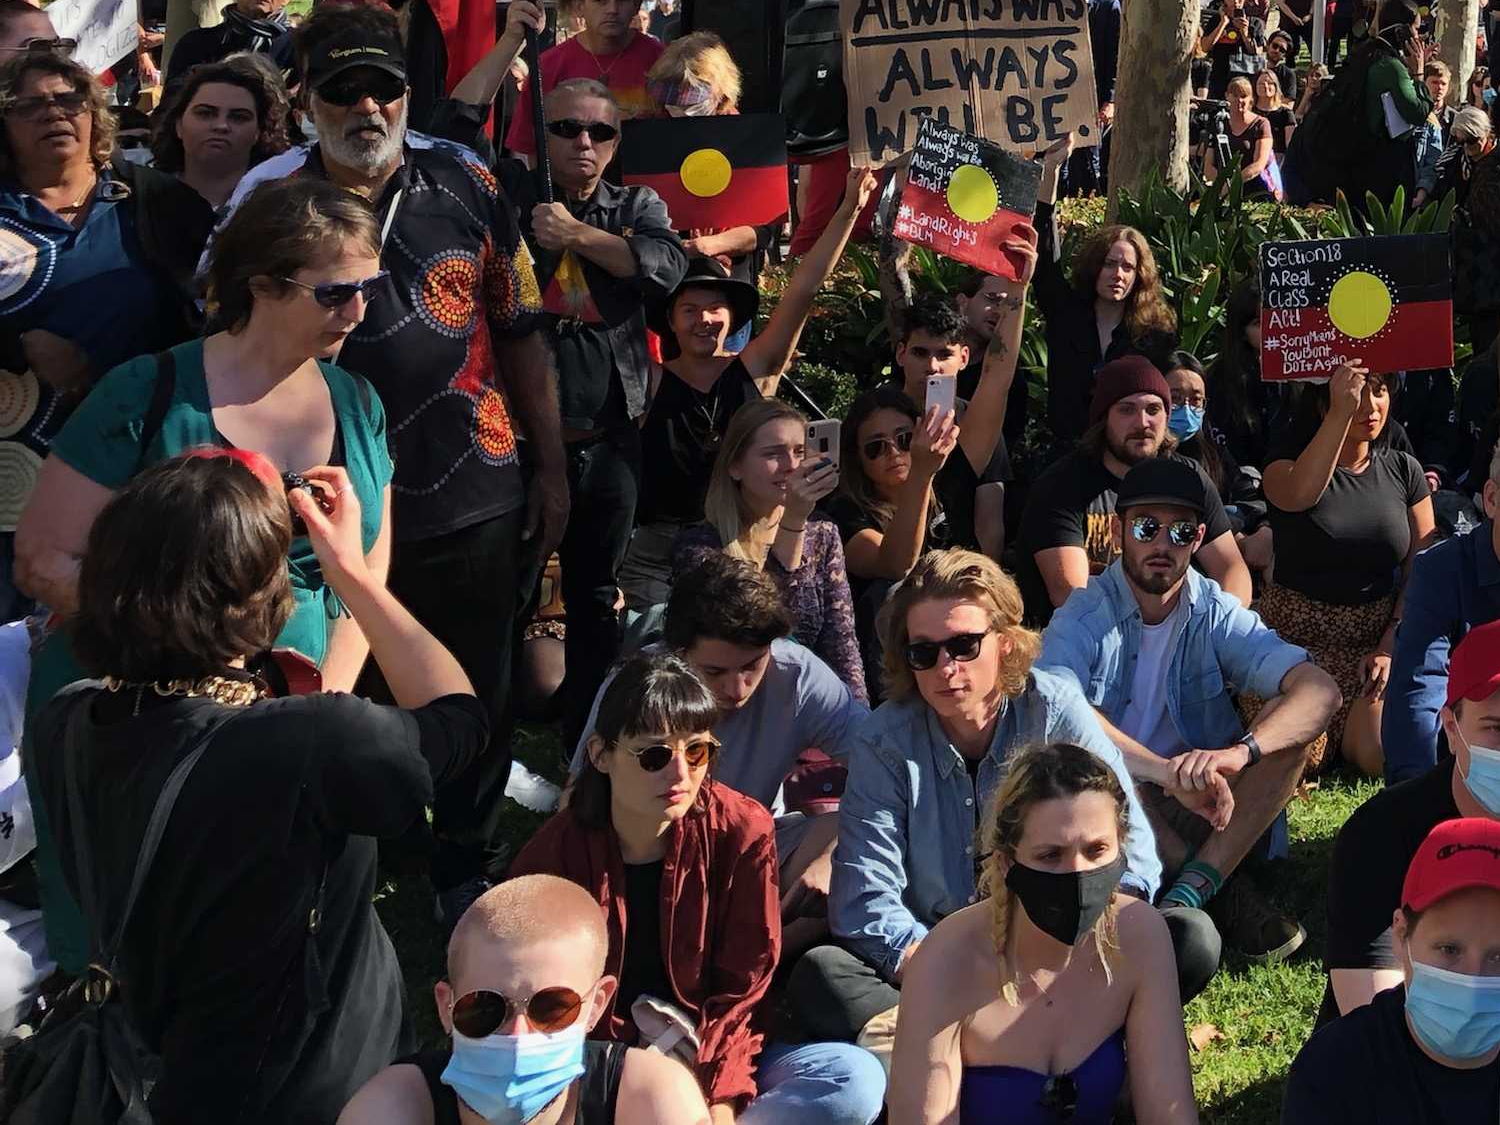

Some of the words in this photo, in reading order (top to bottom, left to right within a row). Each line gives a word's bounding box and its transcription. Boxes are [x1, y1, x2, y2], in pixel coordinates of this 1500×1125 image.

[879, 39, 1078, 102] ALWAYS
[1006, 94, 1090, 143] BE.
[917, 135, 954, 163] Always
[920, 119, 959, 145] Always
[961, 133, 979, 155] was
[908, 171, 942, 194] Land!
[898, 221, 934, 243] #BLM
